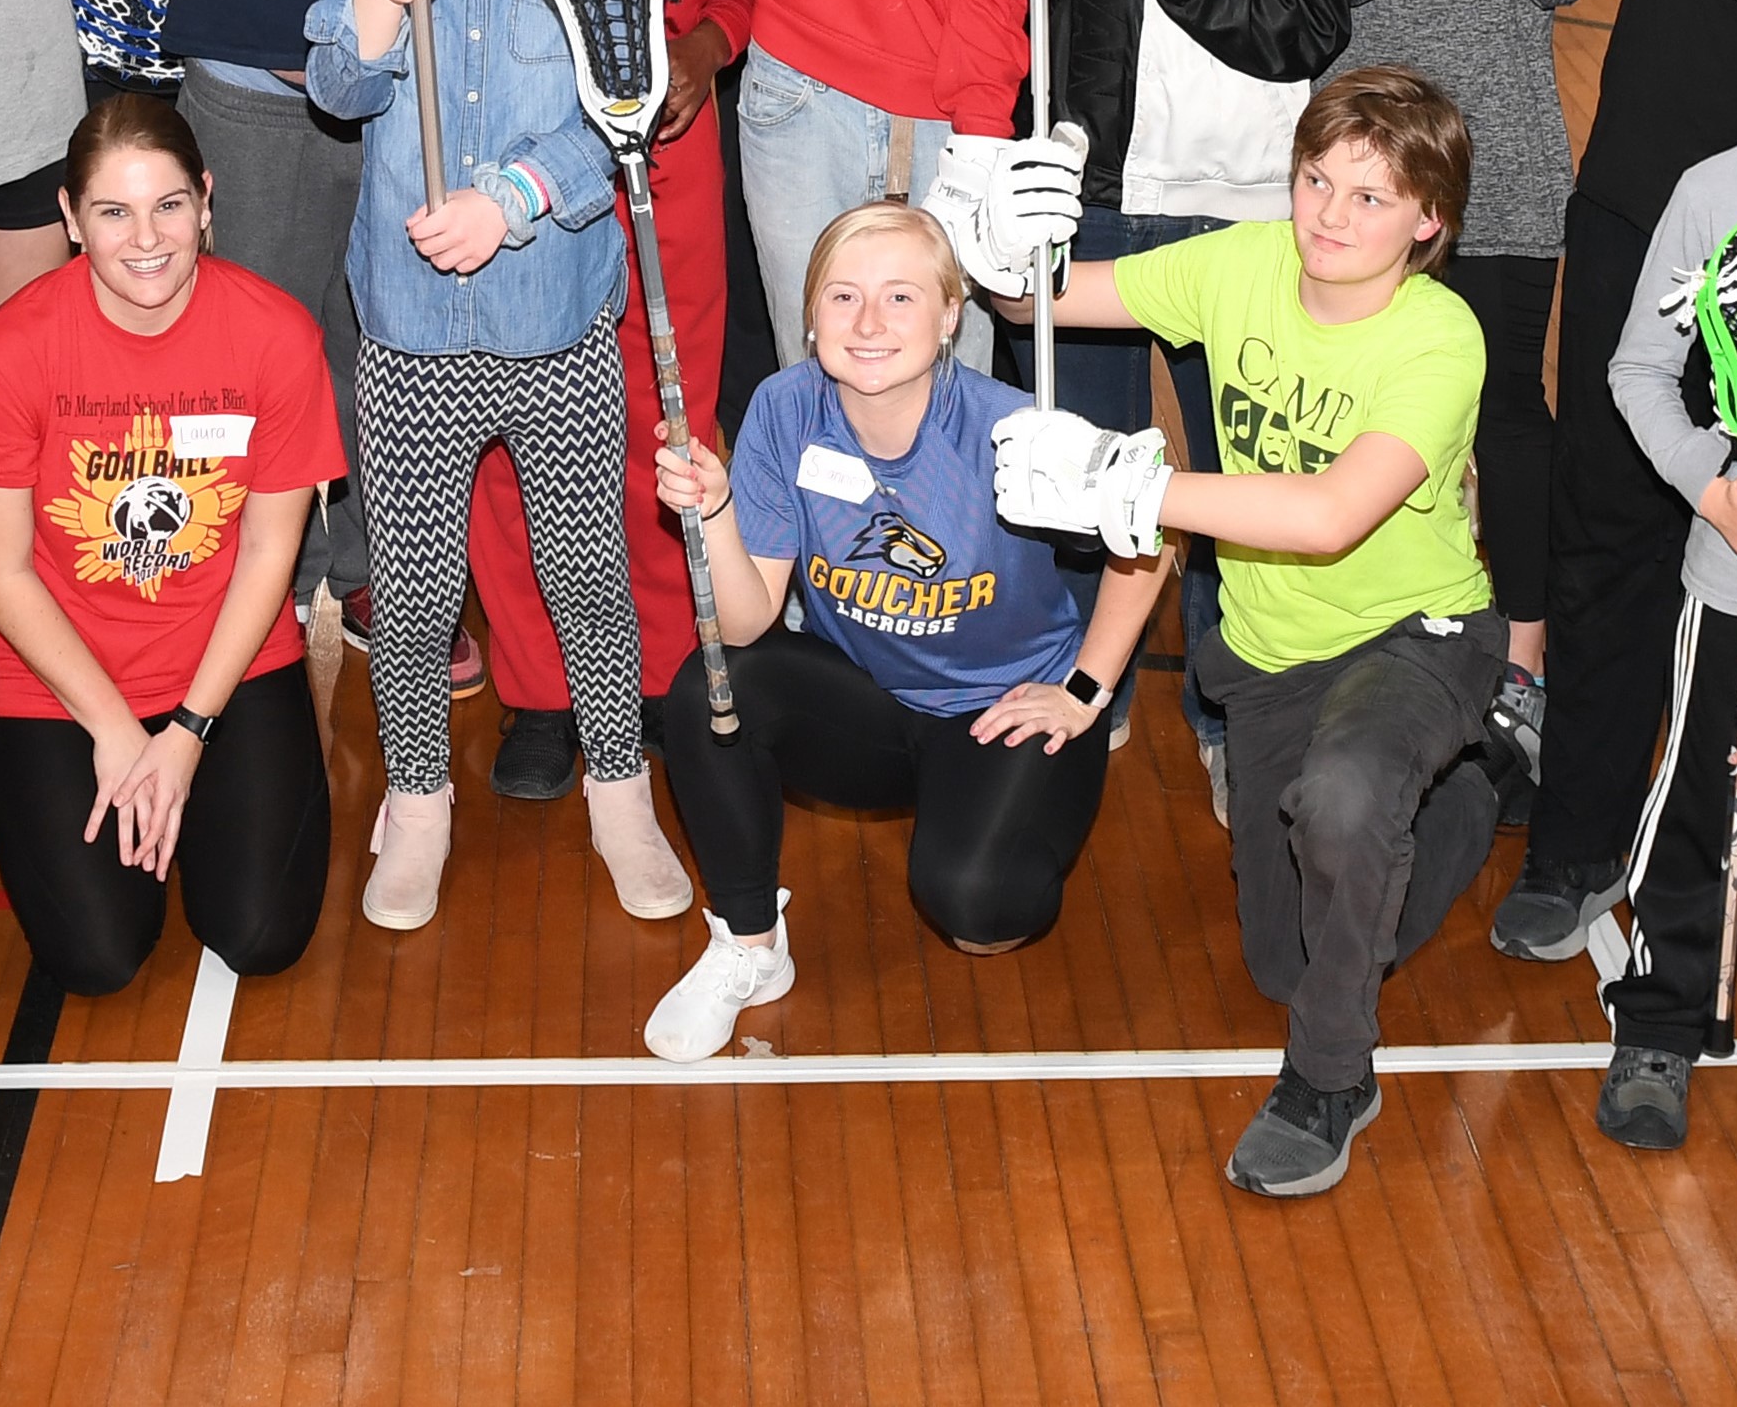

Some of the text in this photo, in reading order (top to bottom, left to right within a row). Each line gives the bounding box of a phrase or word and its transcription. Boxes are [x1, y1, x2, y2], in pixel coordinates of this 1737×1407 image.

[75, 394, 130, 424] Maryland
[133, 390, 175, 416] School
[178, 390, 196, 413] for
[199, 390, 218, 412] the
[180, 428, 226, 445] Laura
[102, 538, 168, 562] WORLD
[122, 551, 191, 579] RECORD
[808, 553, 997, 619] GOUCHER
[836, 600, 958, 637] LACROSSE
